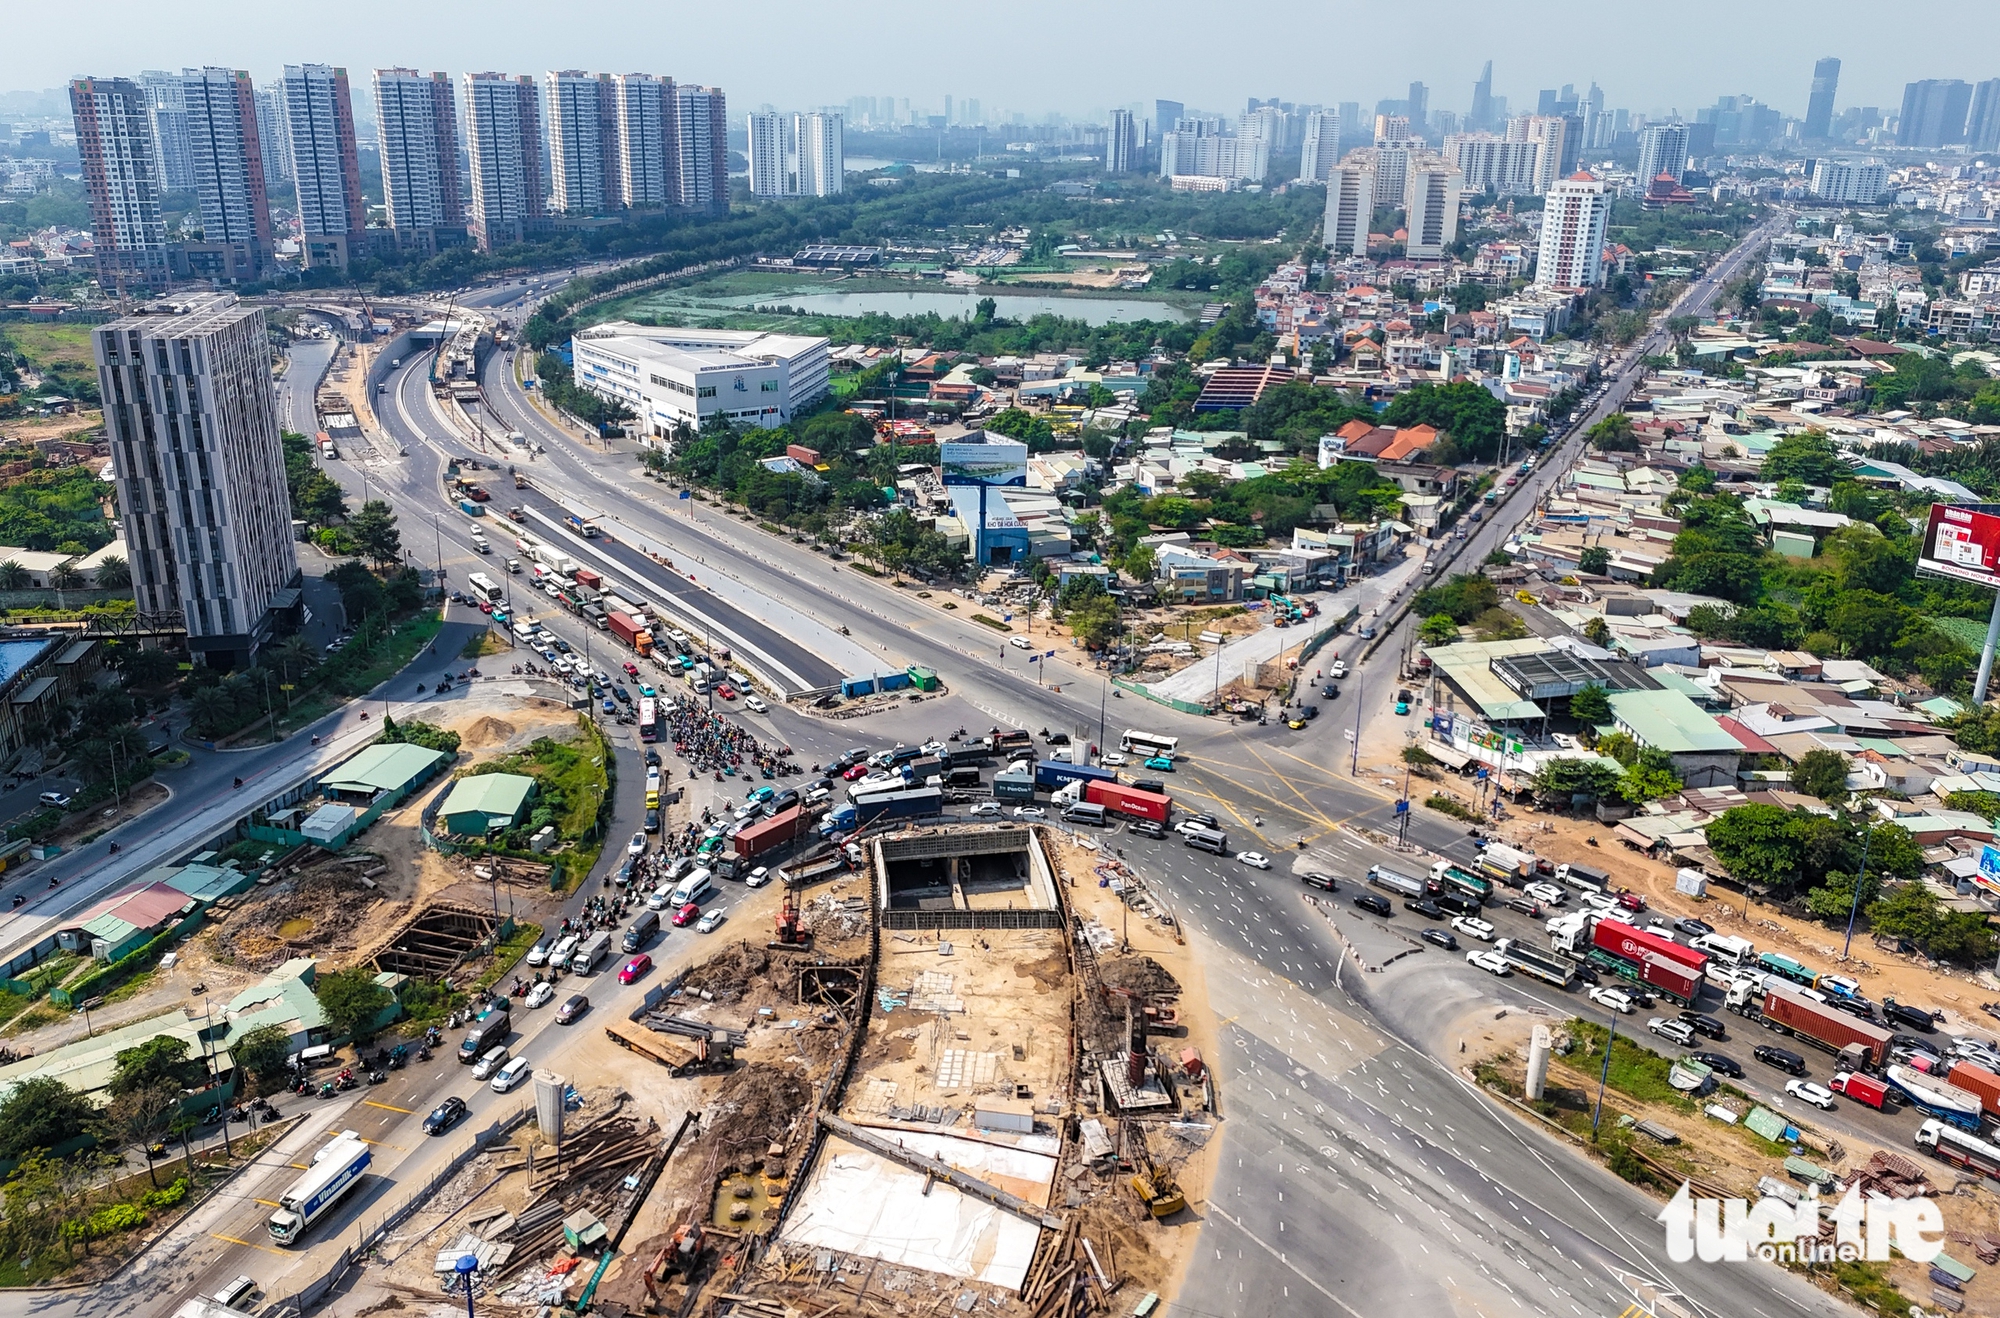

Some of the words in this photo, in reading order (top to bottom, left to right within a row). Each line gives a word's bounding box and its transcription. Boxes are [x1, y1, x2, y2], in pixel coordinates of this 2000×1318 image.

[1942, 566, 1970, 576] BOOKING
[1056, 775, 1083, 783] KMT
[1120, 800, 1148, 812] PanOcean
[318, 1169, 353, 1203] Vinamilk
